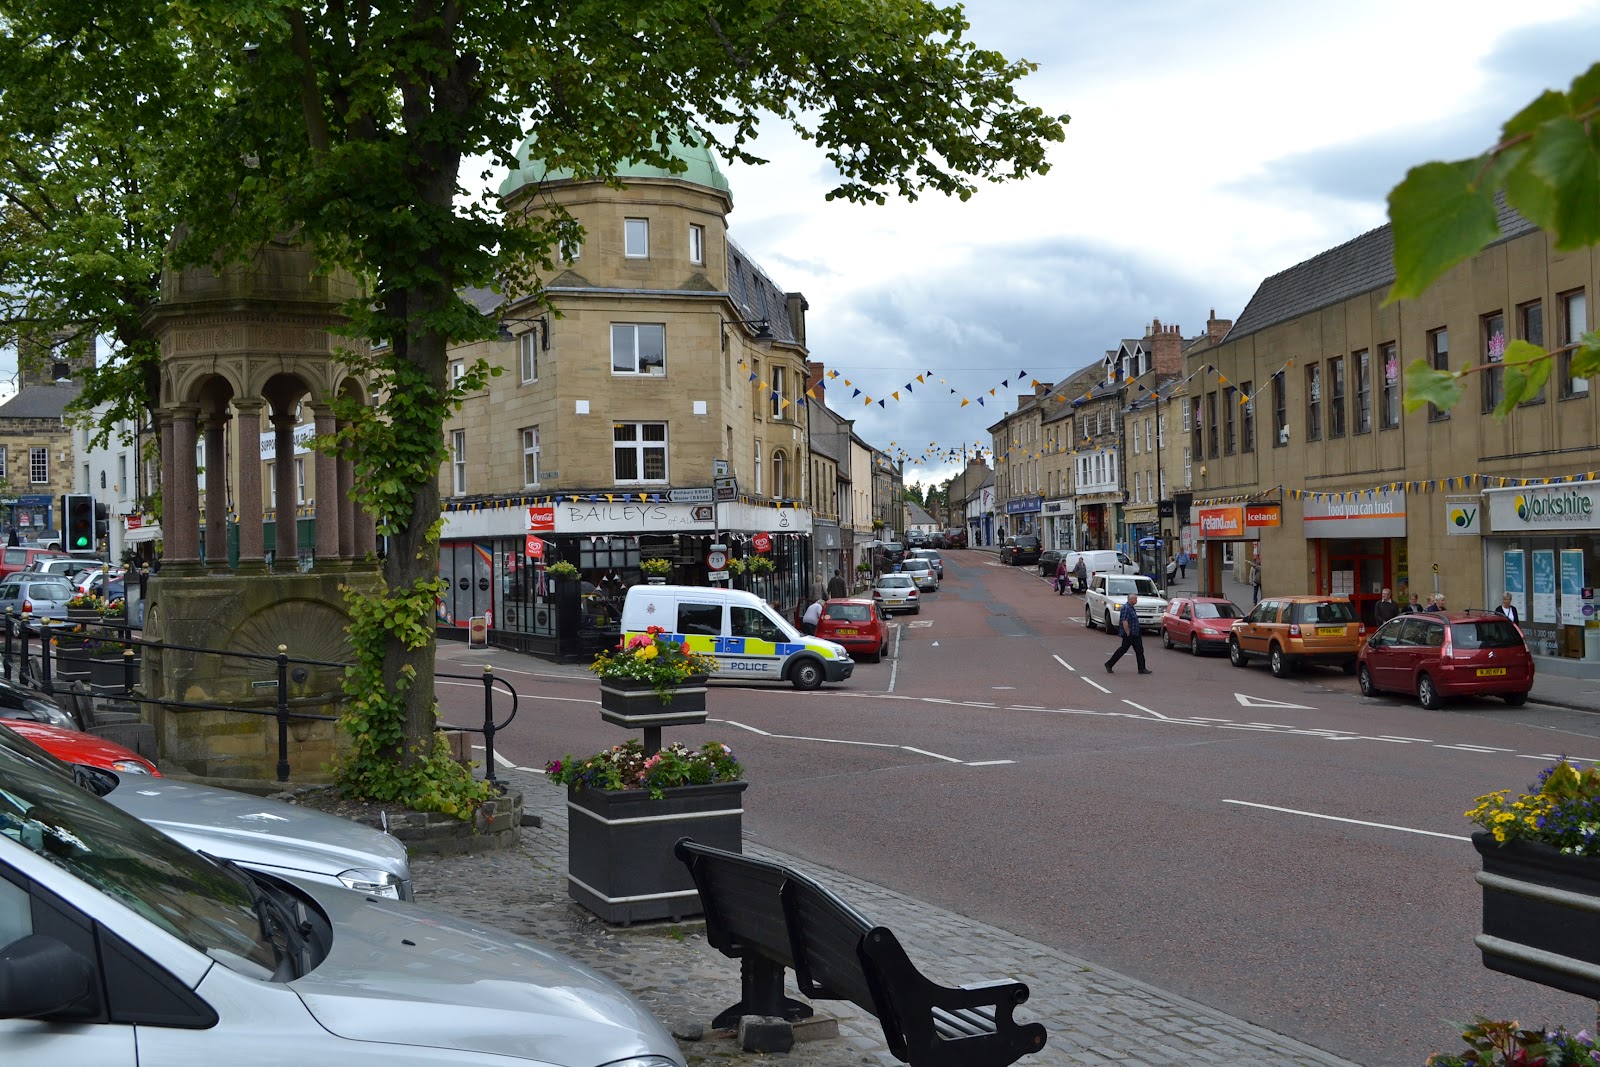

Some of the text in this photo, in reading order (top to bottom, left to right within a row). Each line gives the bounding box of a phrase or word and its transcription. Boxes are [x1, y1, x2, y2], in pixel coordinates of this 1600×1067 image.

[1328, 500, 1394, 520] food you can trust
[1523, 490, 1593, 522] Yorkshire
[532, 513, 554, 522] Coca-Cola
[568, 506, 668, 527] BAILEYS
[1247, 512, 1277, 521] Iceland
[1547, 630, 1557, 638] 100
[731, 662, 768, 672] POLICE
